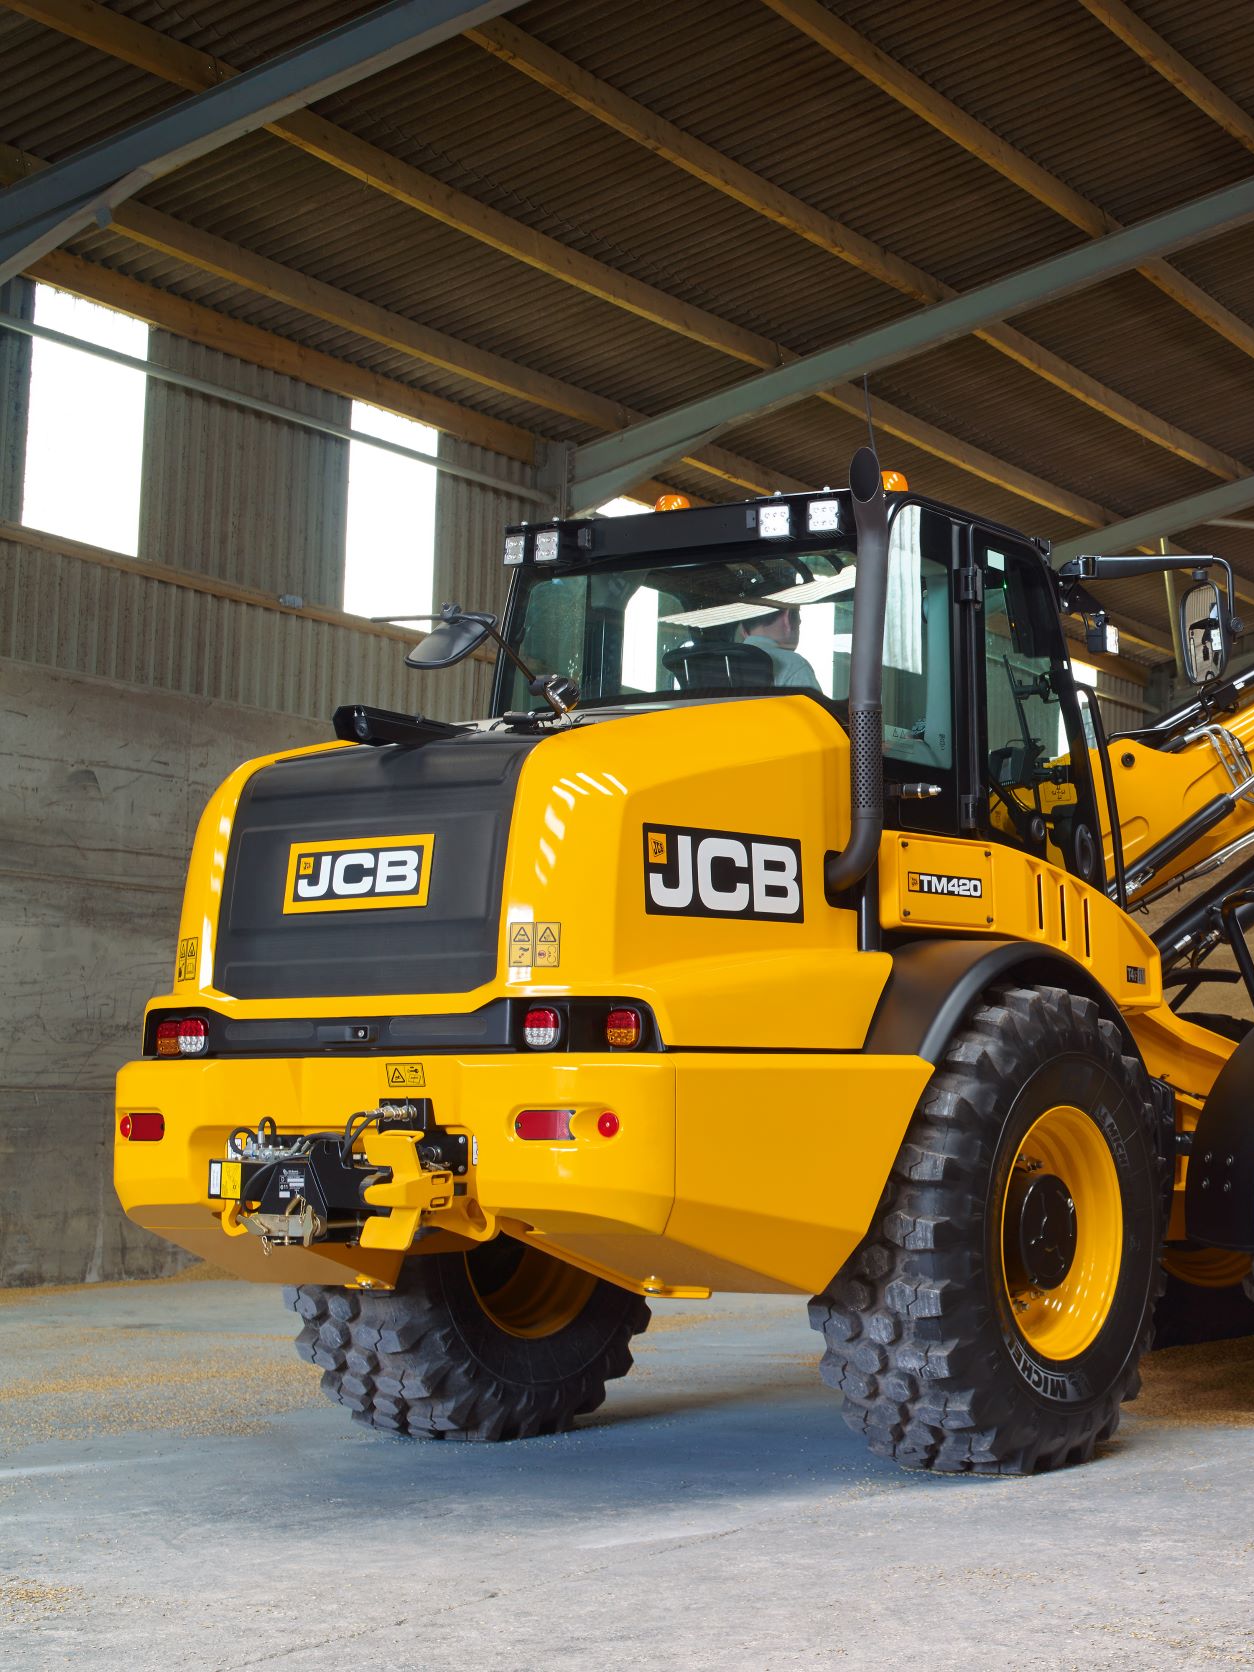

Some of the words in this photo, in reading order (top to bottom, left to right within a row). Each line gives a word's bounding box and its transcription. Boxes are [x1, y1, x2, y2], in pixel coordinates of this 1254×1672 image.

[297, 849, 419, 898] JCB
[649, 834, 800, 914] JCB
[919, 874, 982, 897] TM420
[1007, 1336, 1068, 1401] MICHEL
